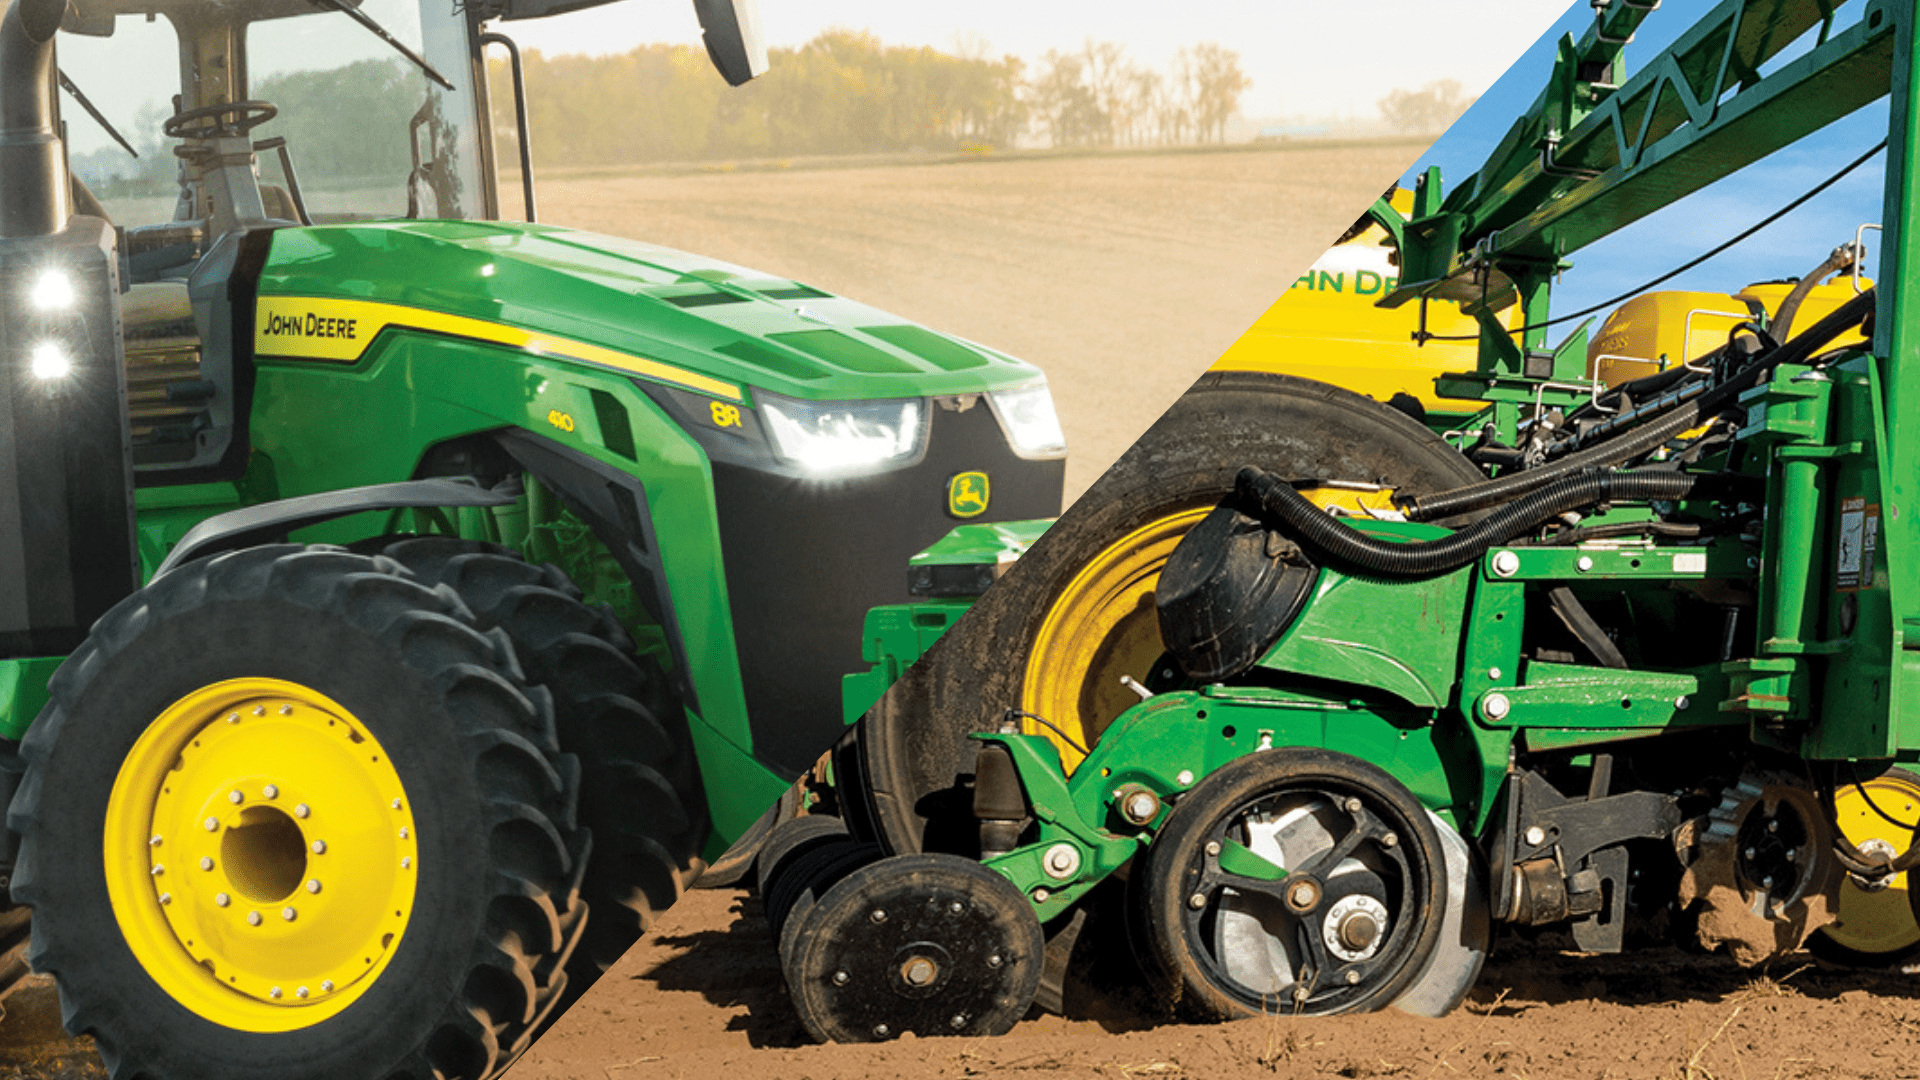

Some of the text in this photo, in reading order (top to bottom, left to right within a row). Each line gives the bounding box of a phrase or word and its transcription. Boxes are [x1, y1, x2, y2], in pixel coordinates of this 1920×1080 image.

[263, 310, 357, 340] JOHN DEERE
[709, 401, 742, 428] 8R
